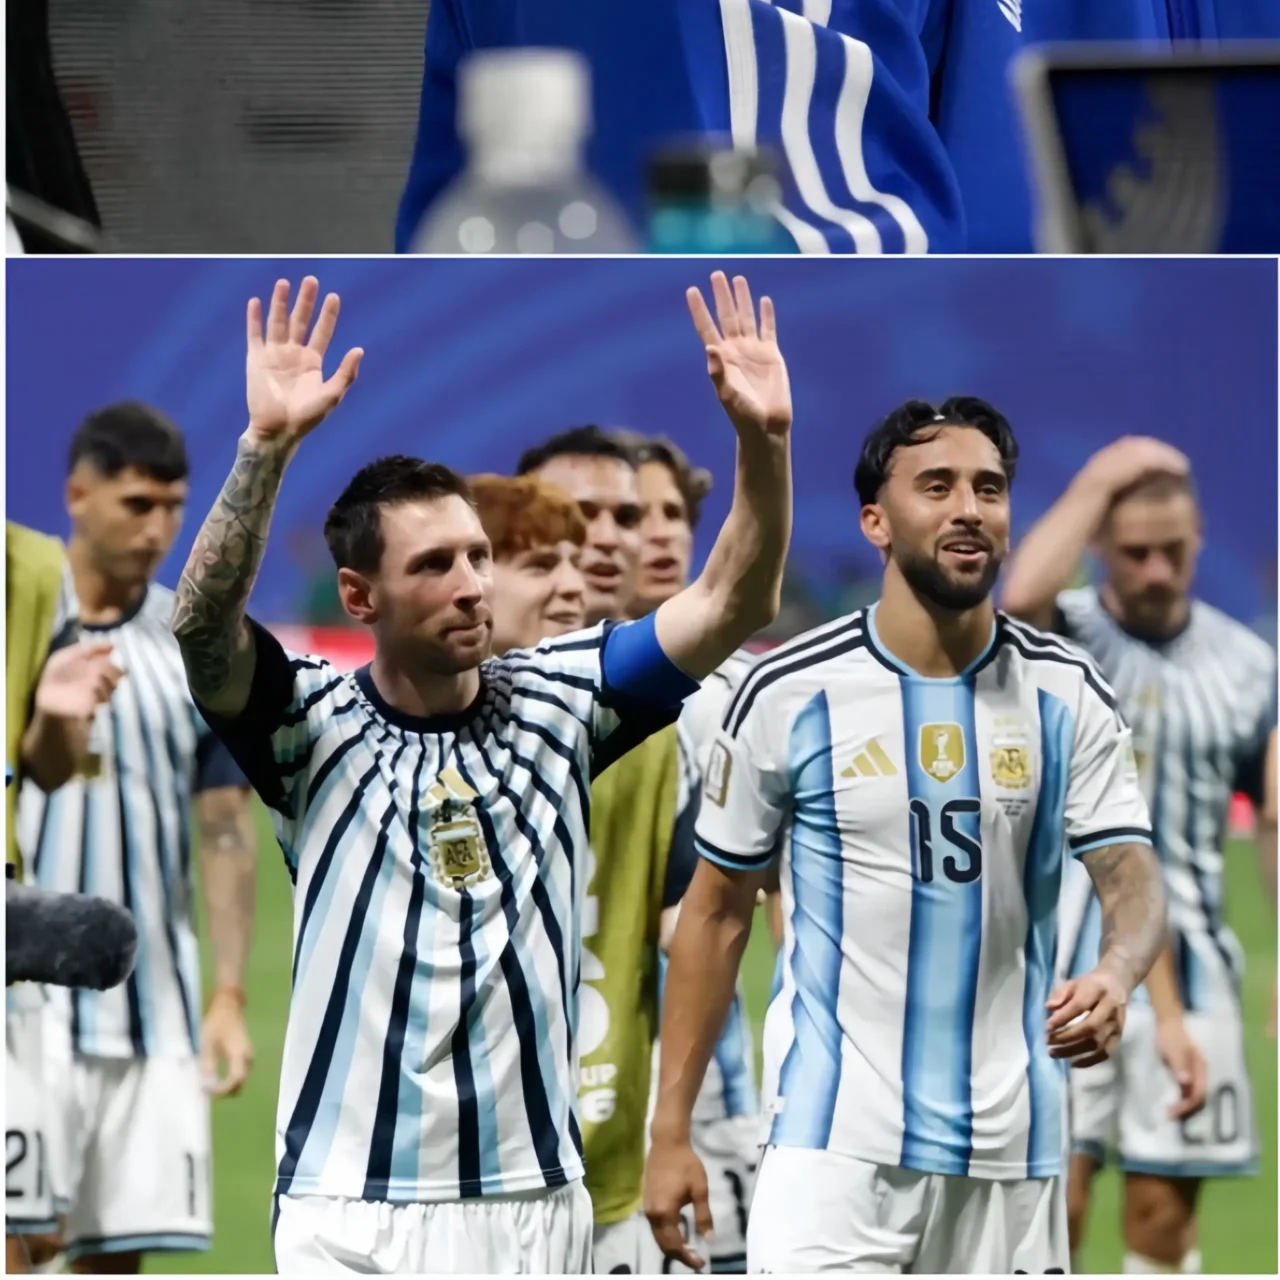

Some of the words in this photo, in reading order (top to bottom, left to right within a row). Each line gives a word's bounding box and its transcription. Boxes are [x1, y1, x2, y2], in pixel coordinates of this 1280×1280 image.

[909, 798, 983, 885] 15
[579, 1063, 617, 1087] UP
[5, 1129, 44, 1199] 21
